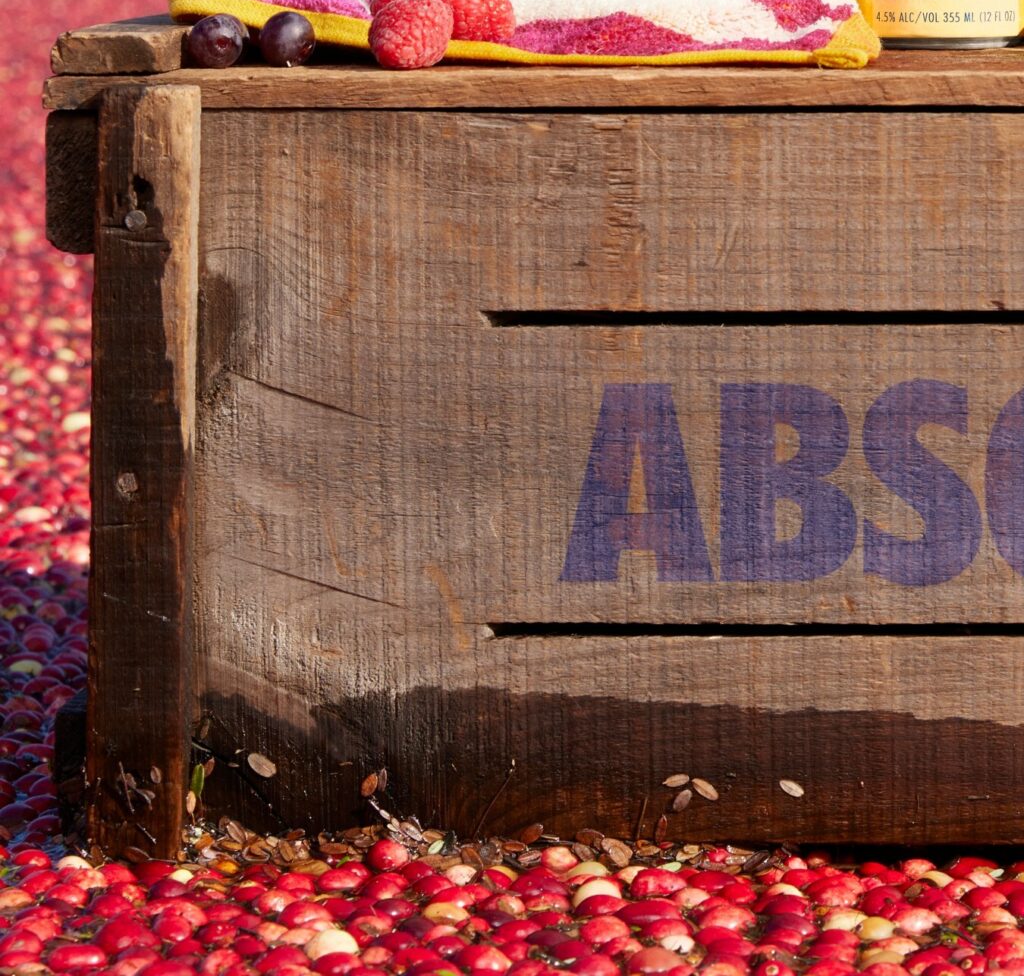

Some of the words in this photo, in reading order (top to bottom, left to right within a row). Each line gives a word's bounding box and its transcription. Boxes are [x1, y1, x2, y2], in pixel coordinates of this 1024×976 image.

[876, 12, 895, 22] 4.5%
[898, 11, 939, 24] ALC/VOL
[943, 12, 960, 22] 355
[964, 12, 976, 22] ML
[979, 11, 991, 23] (12
[994, 11, 1002, 22] FL
